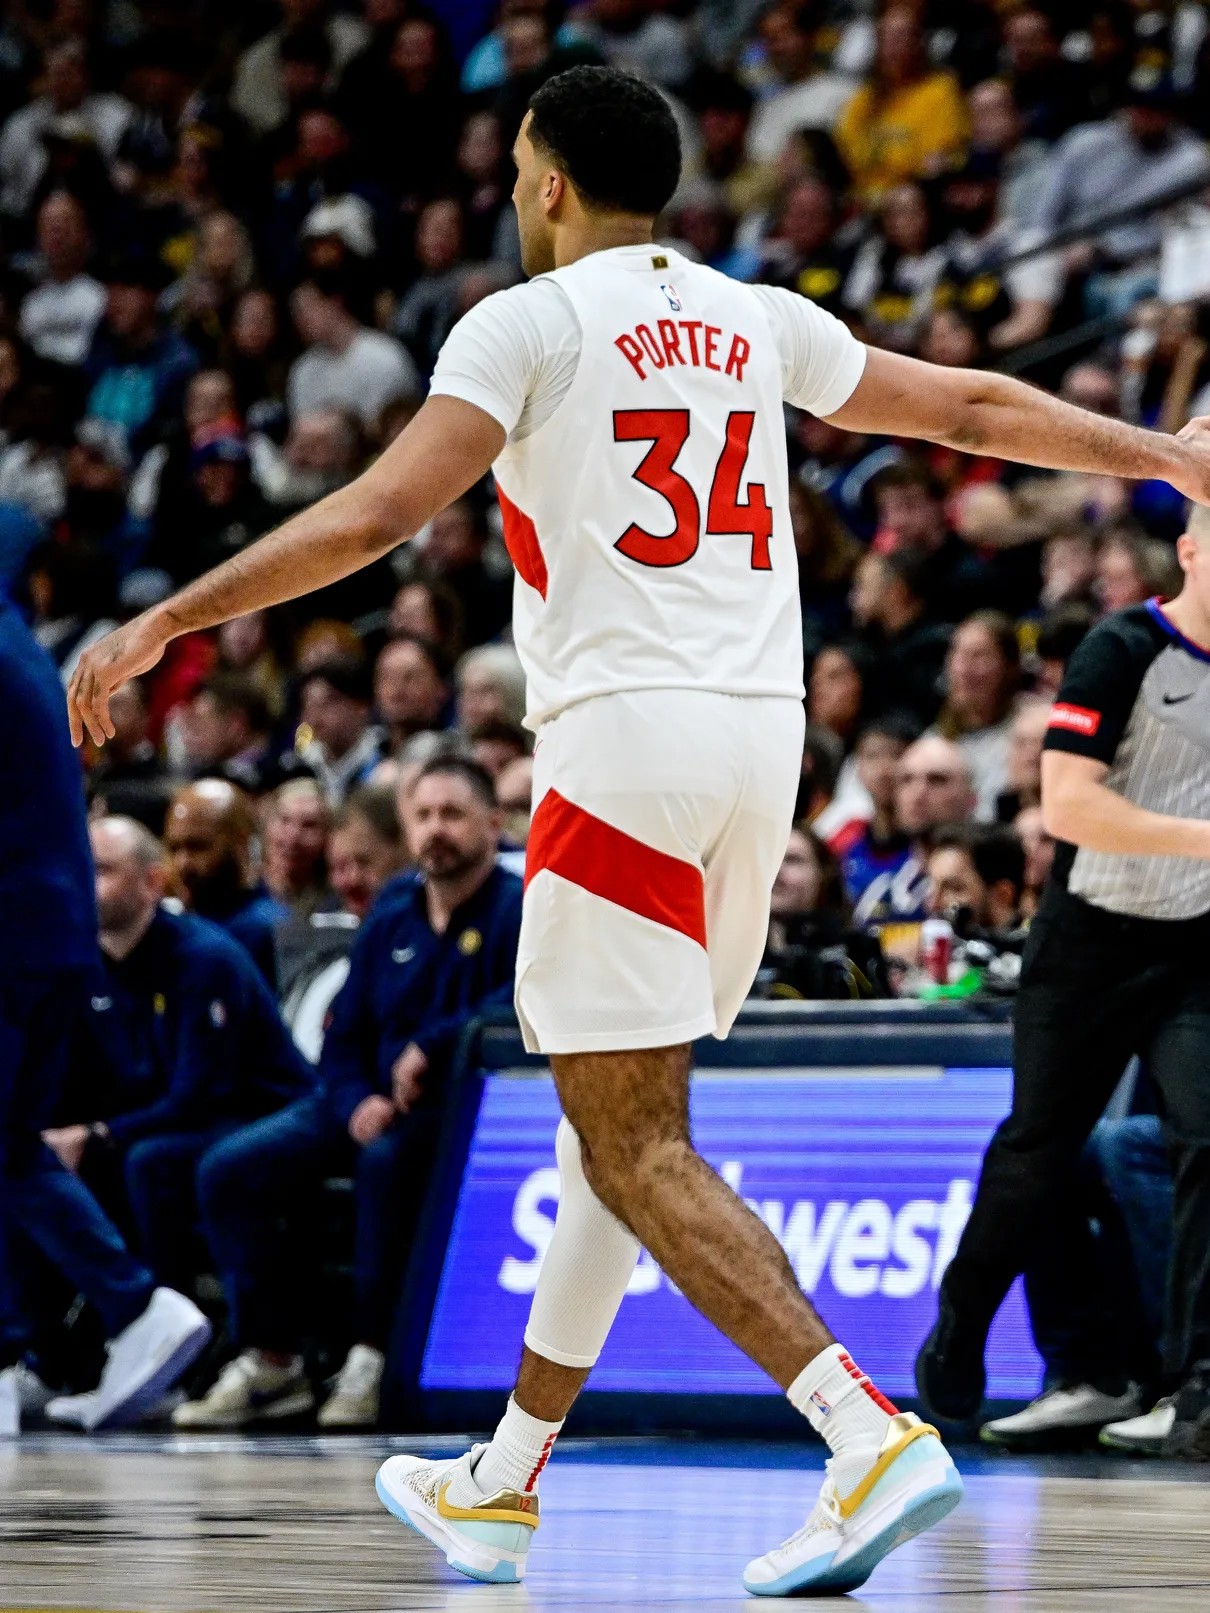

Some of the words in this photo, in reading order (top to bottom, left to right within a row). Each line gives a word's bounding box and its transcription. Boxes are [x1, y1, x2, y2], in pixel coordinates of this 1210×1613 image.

[614, 318, 751, 383] PORTER
[612, 408, 773, 571] 34
[497, 1160, 978, 1298] Swest
